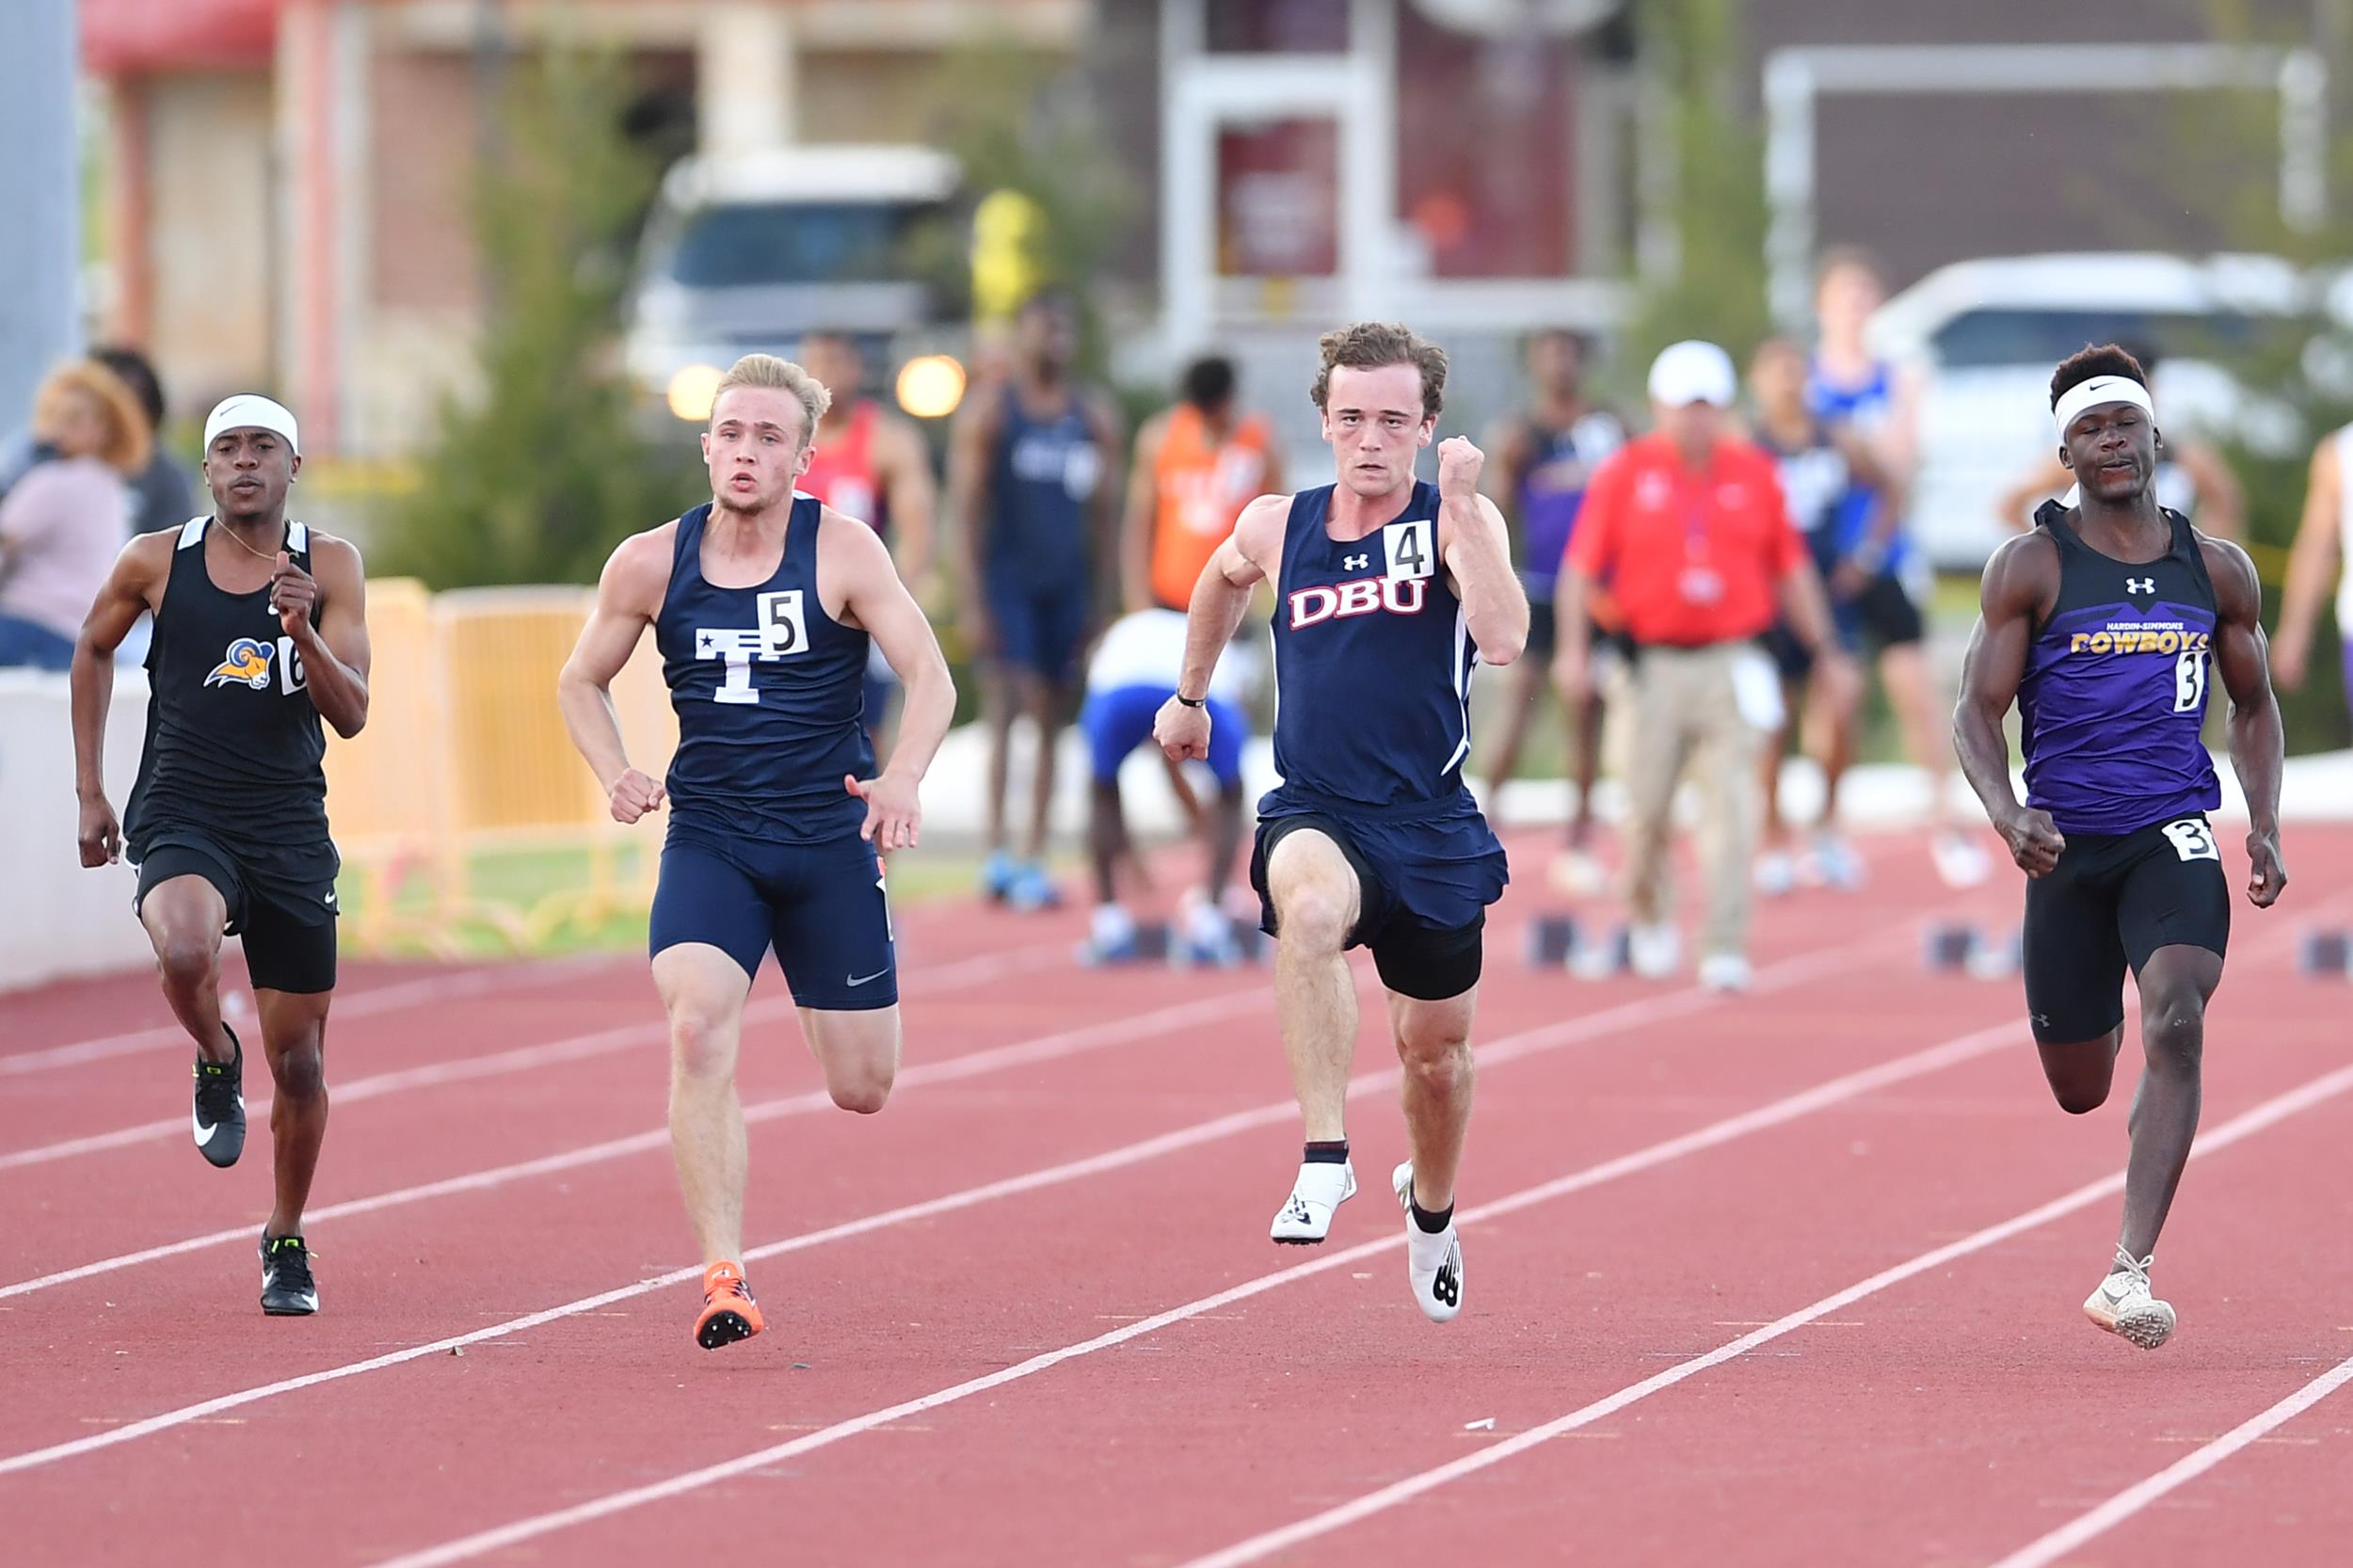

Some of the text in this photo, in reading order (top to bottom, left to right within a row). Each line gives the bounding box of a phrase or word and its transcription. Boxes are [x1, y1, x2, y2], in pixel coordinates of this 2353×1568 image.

[1395, 525, 1425, 574] 4
[770, 596, 796, 651] 5
[1288, 574, 1429, 632] DBU
[2106, 622, 2184, 631] HARDIN-SIMMONS
[696, 629, 780, 704] T
[2182, 653, 2198, 708] 3
[2174, 822, 2210, 855] 3
